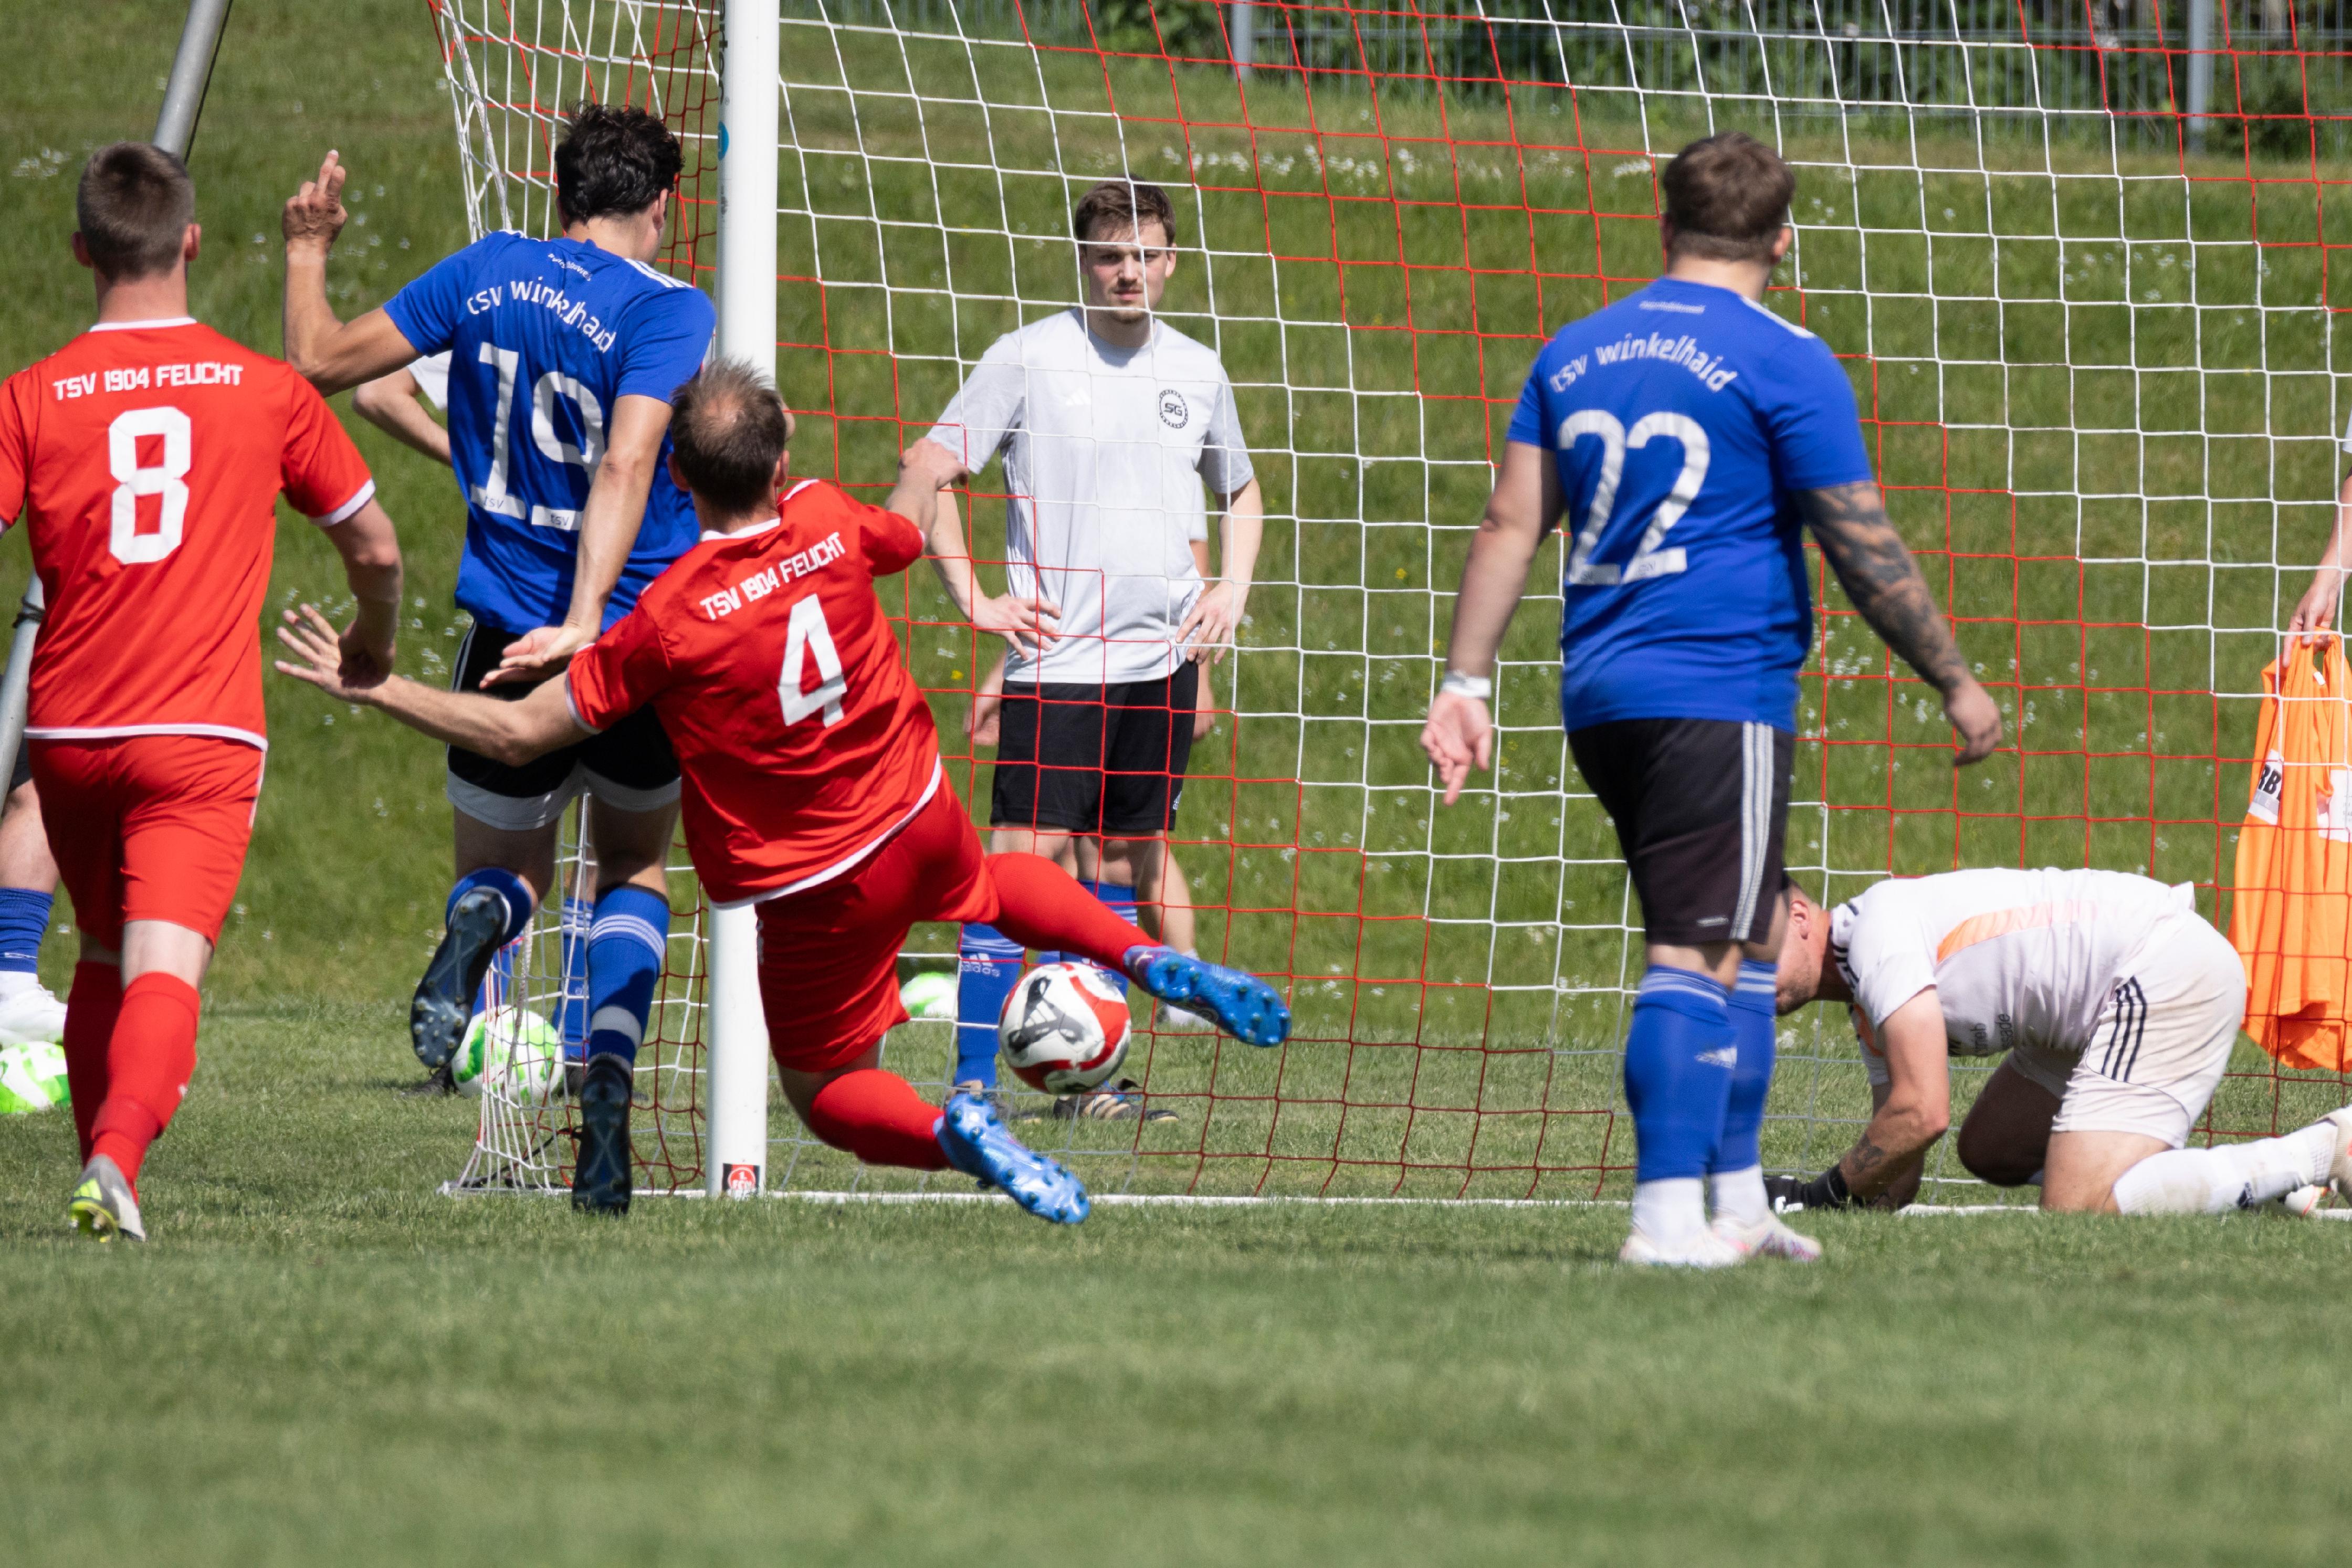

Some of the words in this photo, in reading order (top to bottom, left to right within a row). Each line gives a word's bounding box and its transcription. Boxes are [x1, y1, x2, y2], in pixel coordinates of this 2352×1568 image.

[53, 373, 96, 401] TSV
[104, 367, 150, 392] 1904
[156, 362, 243, 387] FEUCHT
[1163, 403, 1183, 417] SG
[1595, 332, 1738, 392] winkelhaid
[108, 406, 191, 565] 8
[470, 342, 606, 531] 19
[1557, 409, 1710, 585] 22
[699, 587, 741, 620] TSV
[739, 567, 780, 602] 1904
[779, 532, 845, 583] FEUCHT
[777, 593, 847, 729] 4
